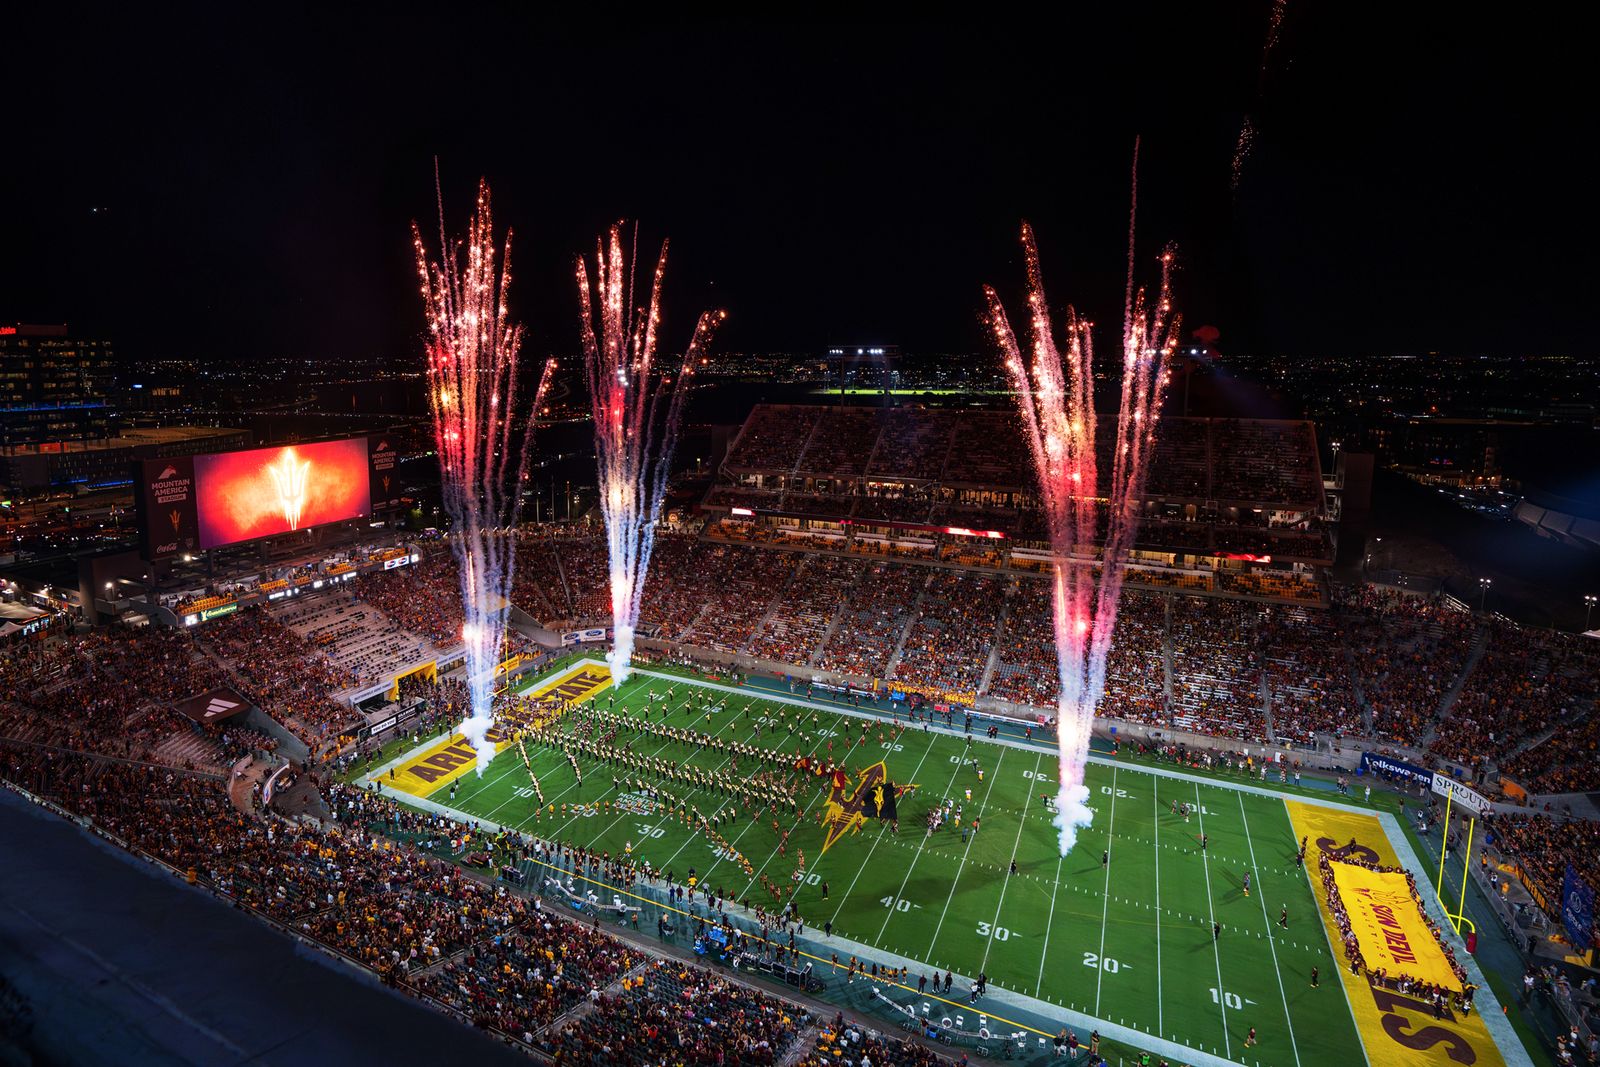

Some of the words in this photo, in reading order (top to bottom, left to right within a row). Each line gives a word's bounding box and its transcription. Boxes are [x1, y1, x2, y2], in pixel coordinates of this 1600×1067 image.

[151, 479, 190, 491] MOUNTAIN
[154, 486, 188, 498] AMERICA
[158, 494, 187, 504] STADIUM
[881, 740, 903, 752] 50
[1022, 770, 1049, 782] 30
[1101, 786, 1126, 797] 20
[1436, 774, 1489, 811] SPROUTS
[637, 823, 666, 840] 30
[880, 894, 911, 914] 40
[1369, 903, 1402, 930] SUN
[975, 920, 1009, 943] 30
[1381, 928, 1418, 964] DEVIL
[1082, 950, 1119, 974] 20
[1208, 986, 1243, 1011] 10
